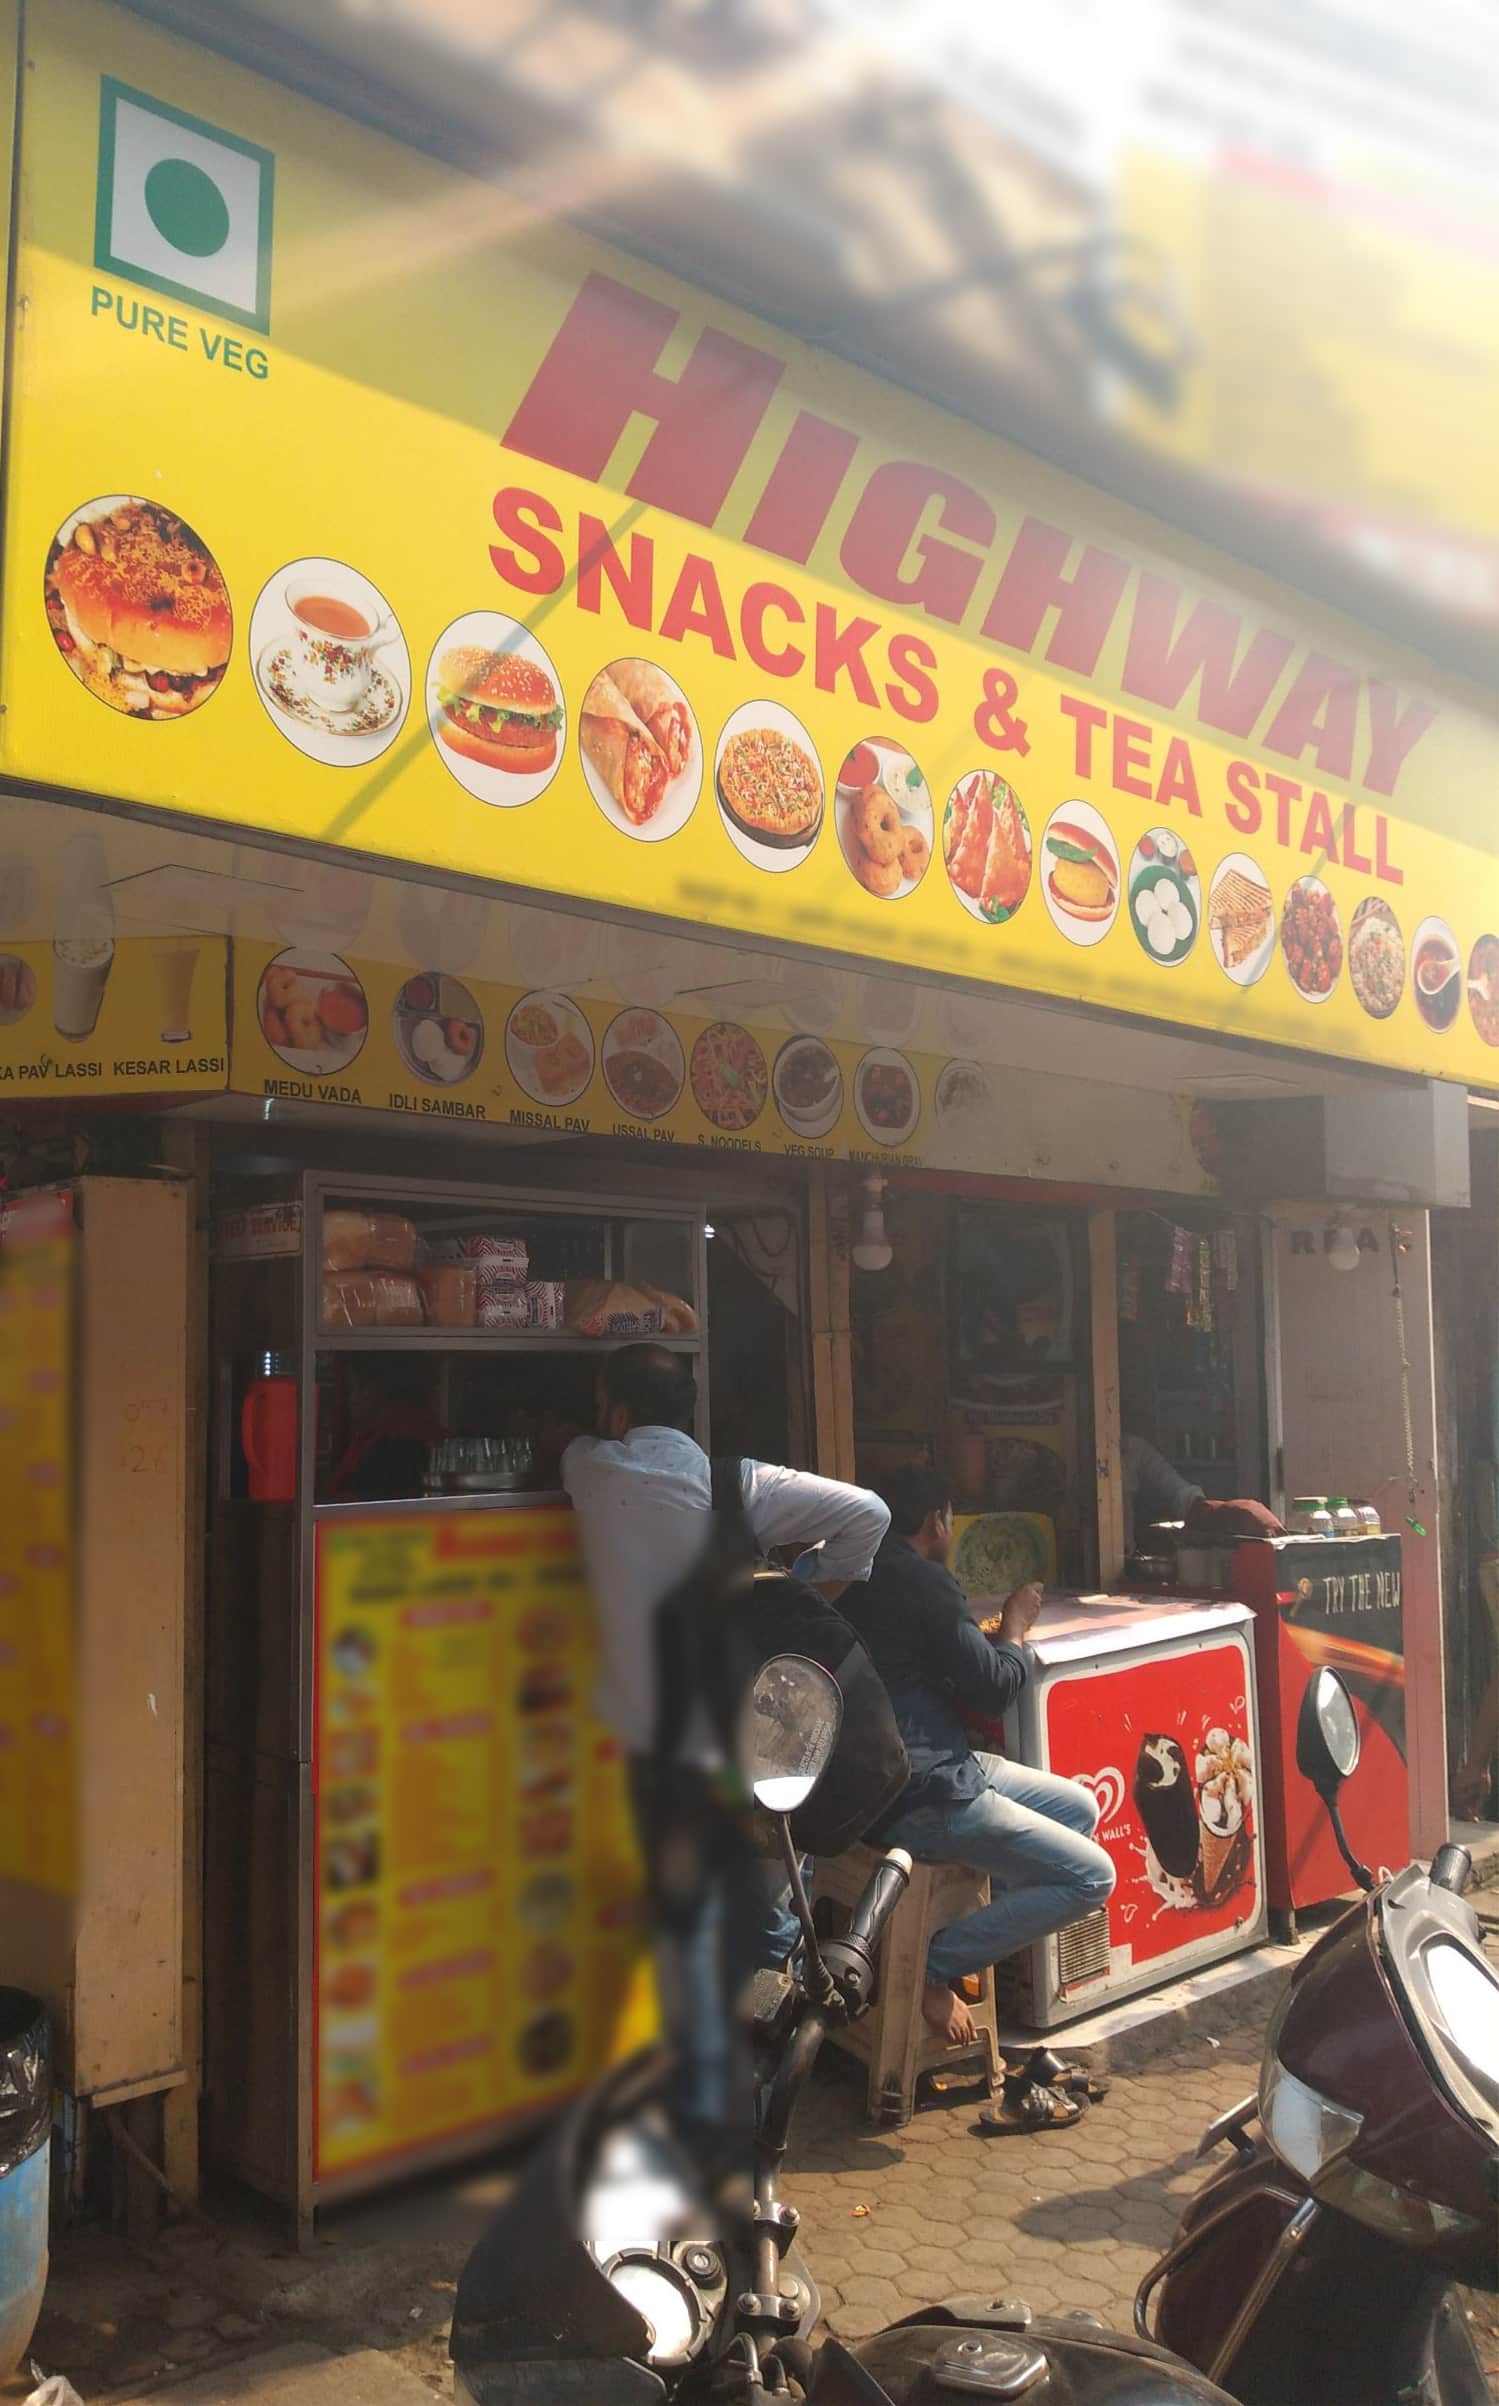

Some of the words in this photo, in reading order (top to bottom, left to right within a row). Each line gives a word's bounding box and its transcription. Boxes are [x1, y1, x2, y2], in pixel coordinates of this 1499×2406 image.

[91, 286, 188, 352] PURE
[199, 327, 270, 380] VEG
[500, 268, 1440, 798] HIGHWAY
[487, 486, 940, 724] SNACKS
[973, 667, 1031, 757] &
[1060, 693, 1202, 817] TEA
[1224, 761, 1405, 886] STALL
[0, 1066, 14, 1080] A
[19, 1064, 49, 1079] PAV
[55, 1062, 102, 1078] LASSI
[113, 1060, 170, 1076] KESAR
[176, 1057, 225, 1074] LASSI
[263, 1079, 313, 1098] MEDU
[317, 1085, 362, 1105] VADA
[388, 1093, 417, 1111] IDLI
[422, 1098, 486, 1119] SAMBAR
[509, 1109, 561, 1129] MISSAL
[564, 1116, 591, 1133] PAV
[654, 1128, 675, 1143] PAV
[1322, 1575, 1345, 1615] TRY
[1348, 1573, 1372, 1613] THE
[1376, 1570, 1400, 1609] NEW
[1102, 1823, 1131, 1841] WALL'S
